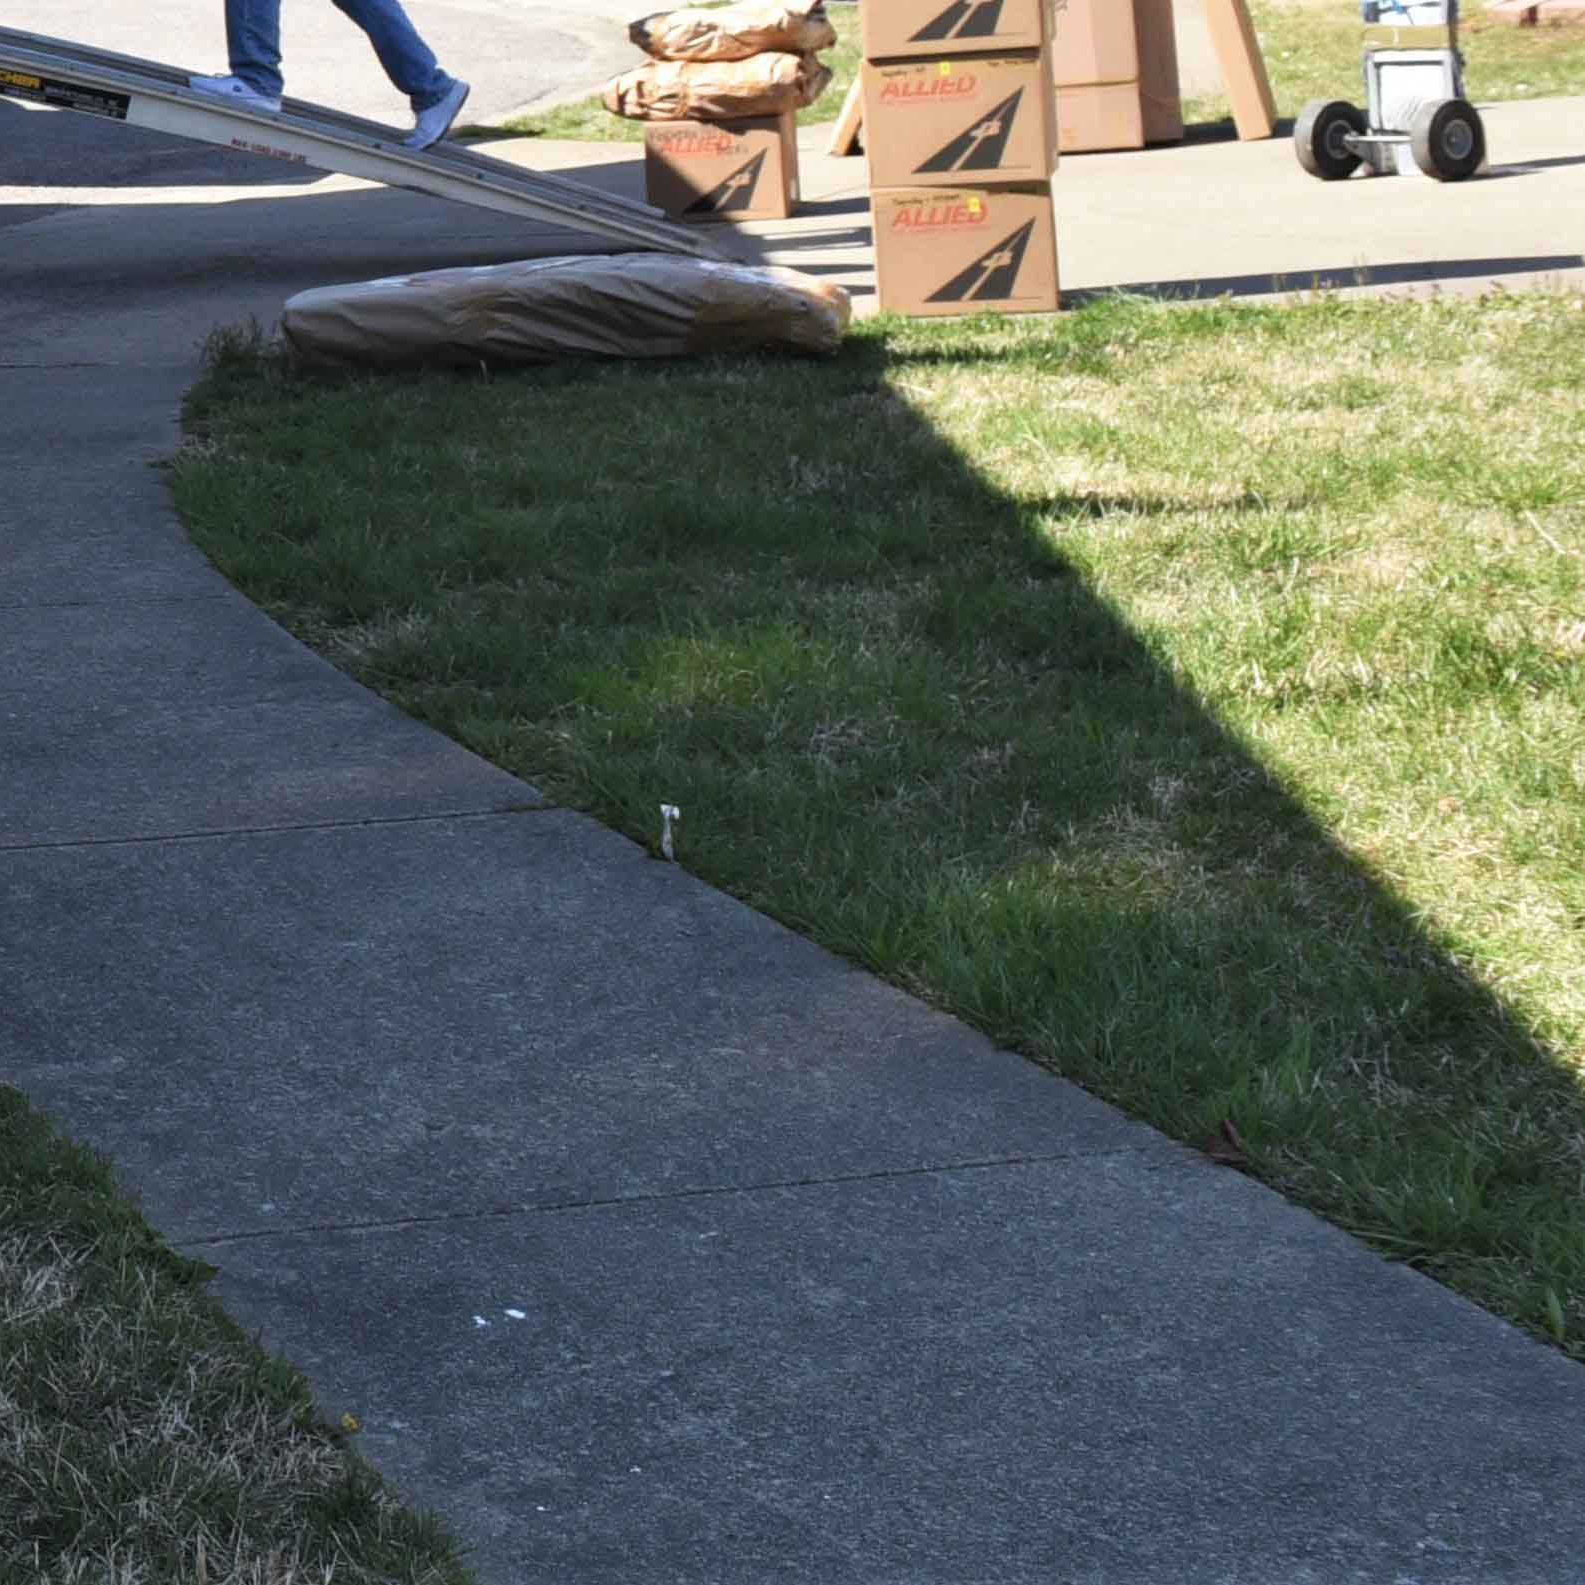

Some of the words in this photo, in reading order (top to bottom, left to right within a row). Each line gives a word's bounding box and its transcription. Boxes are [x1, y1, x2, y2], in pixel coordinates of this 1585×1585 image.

[880, 73, 977, 98] ALLIED
[662, 131, 735, 153] ALLIED
[892, 201, 989, 227] ALLIED
